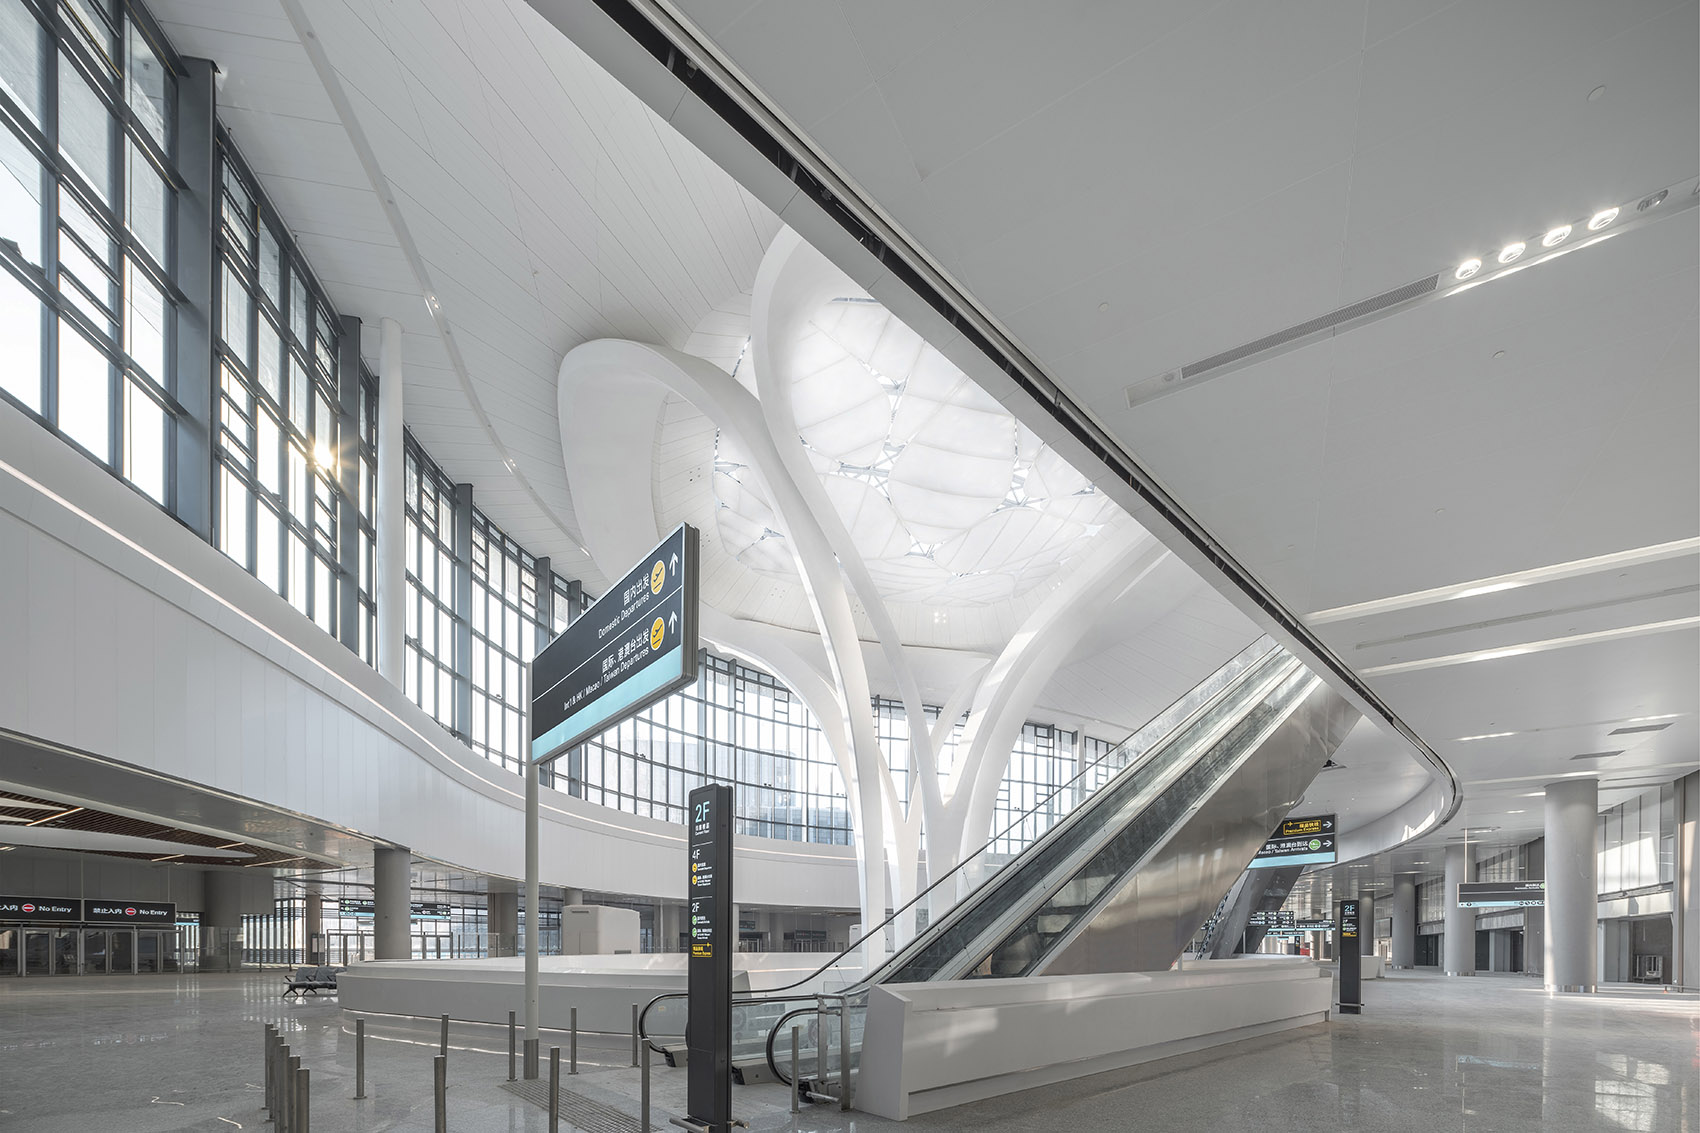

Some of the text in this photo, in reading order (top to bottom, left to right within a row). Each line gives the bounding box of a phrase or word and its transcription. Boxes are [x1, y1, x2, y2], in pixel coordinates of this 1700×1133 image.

[623, 573, 649, 606] 国内出发
[598, 592, 649, 639] Domestic Departures
[602, 628, 649, 673] 国际、港澳台出发
[576, 690, 583, 702] HK
[586, 681, 600, 696] Macao
[603, 667, 620, 684] Taiwan
[620, 647, 649, 672] Departures
[695, 800, 710, 823] 2F
[692, 849, 700, 860] 4F
[51, 905, 72, 913] Entry
[691, 902, 700, 913] 2F
[1344, 904, 1355, 912] 2F
